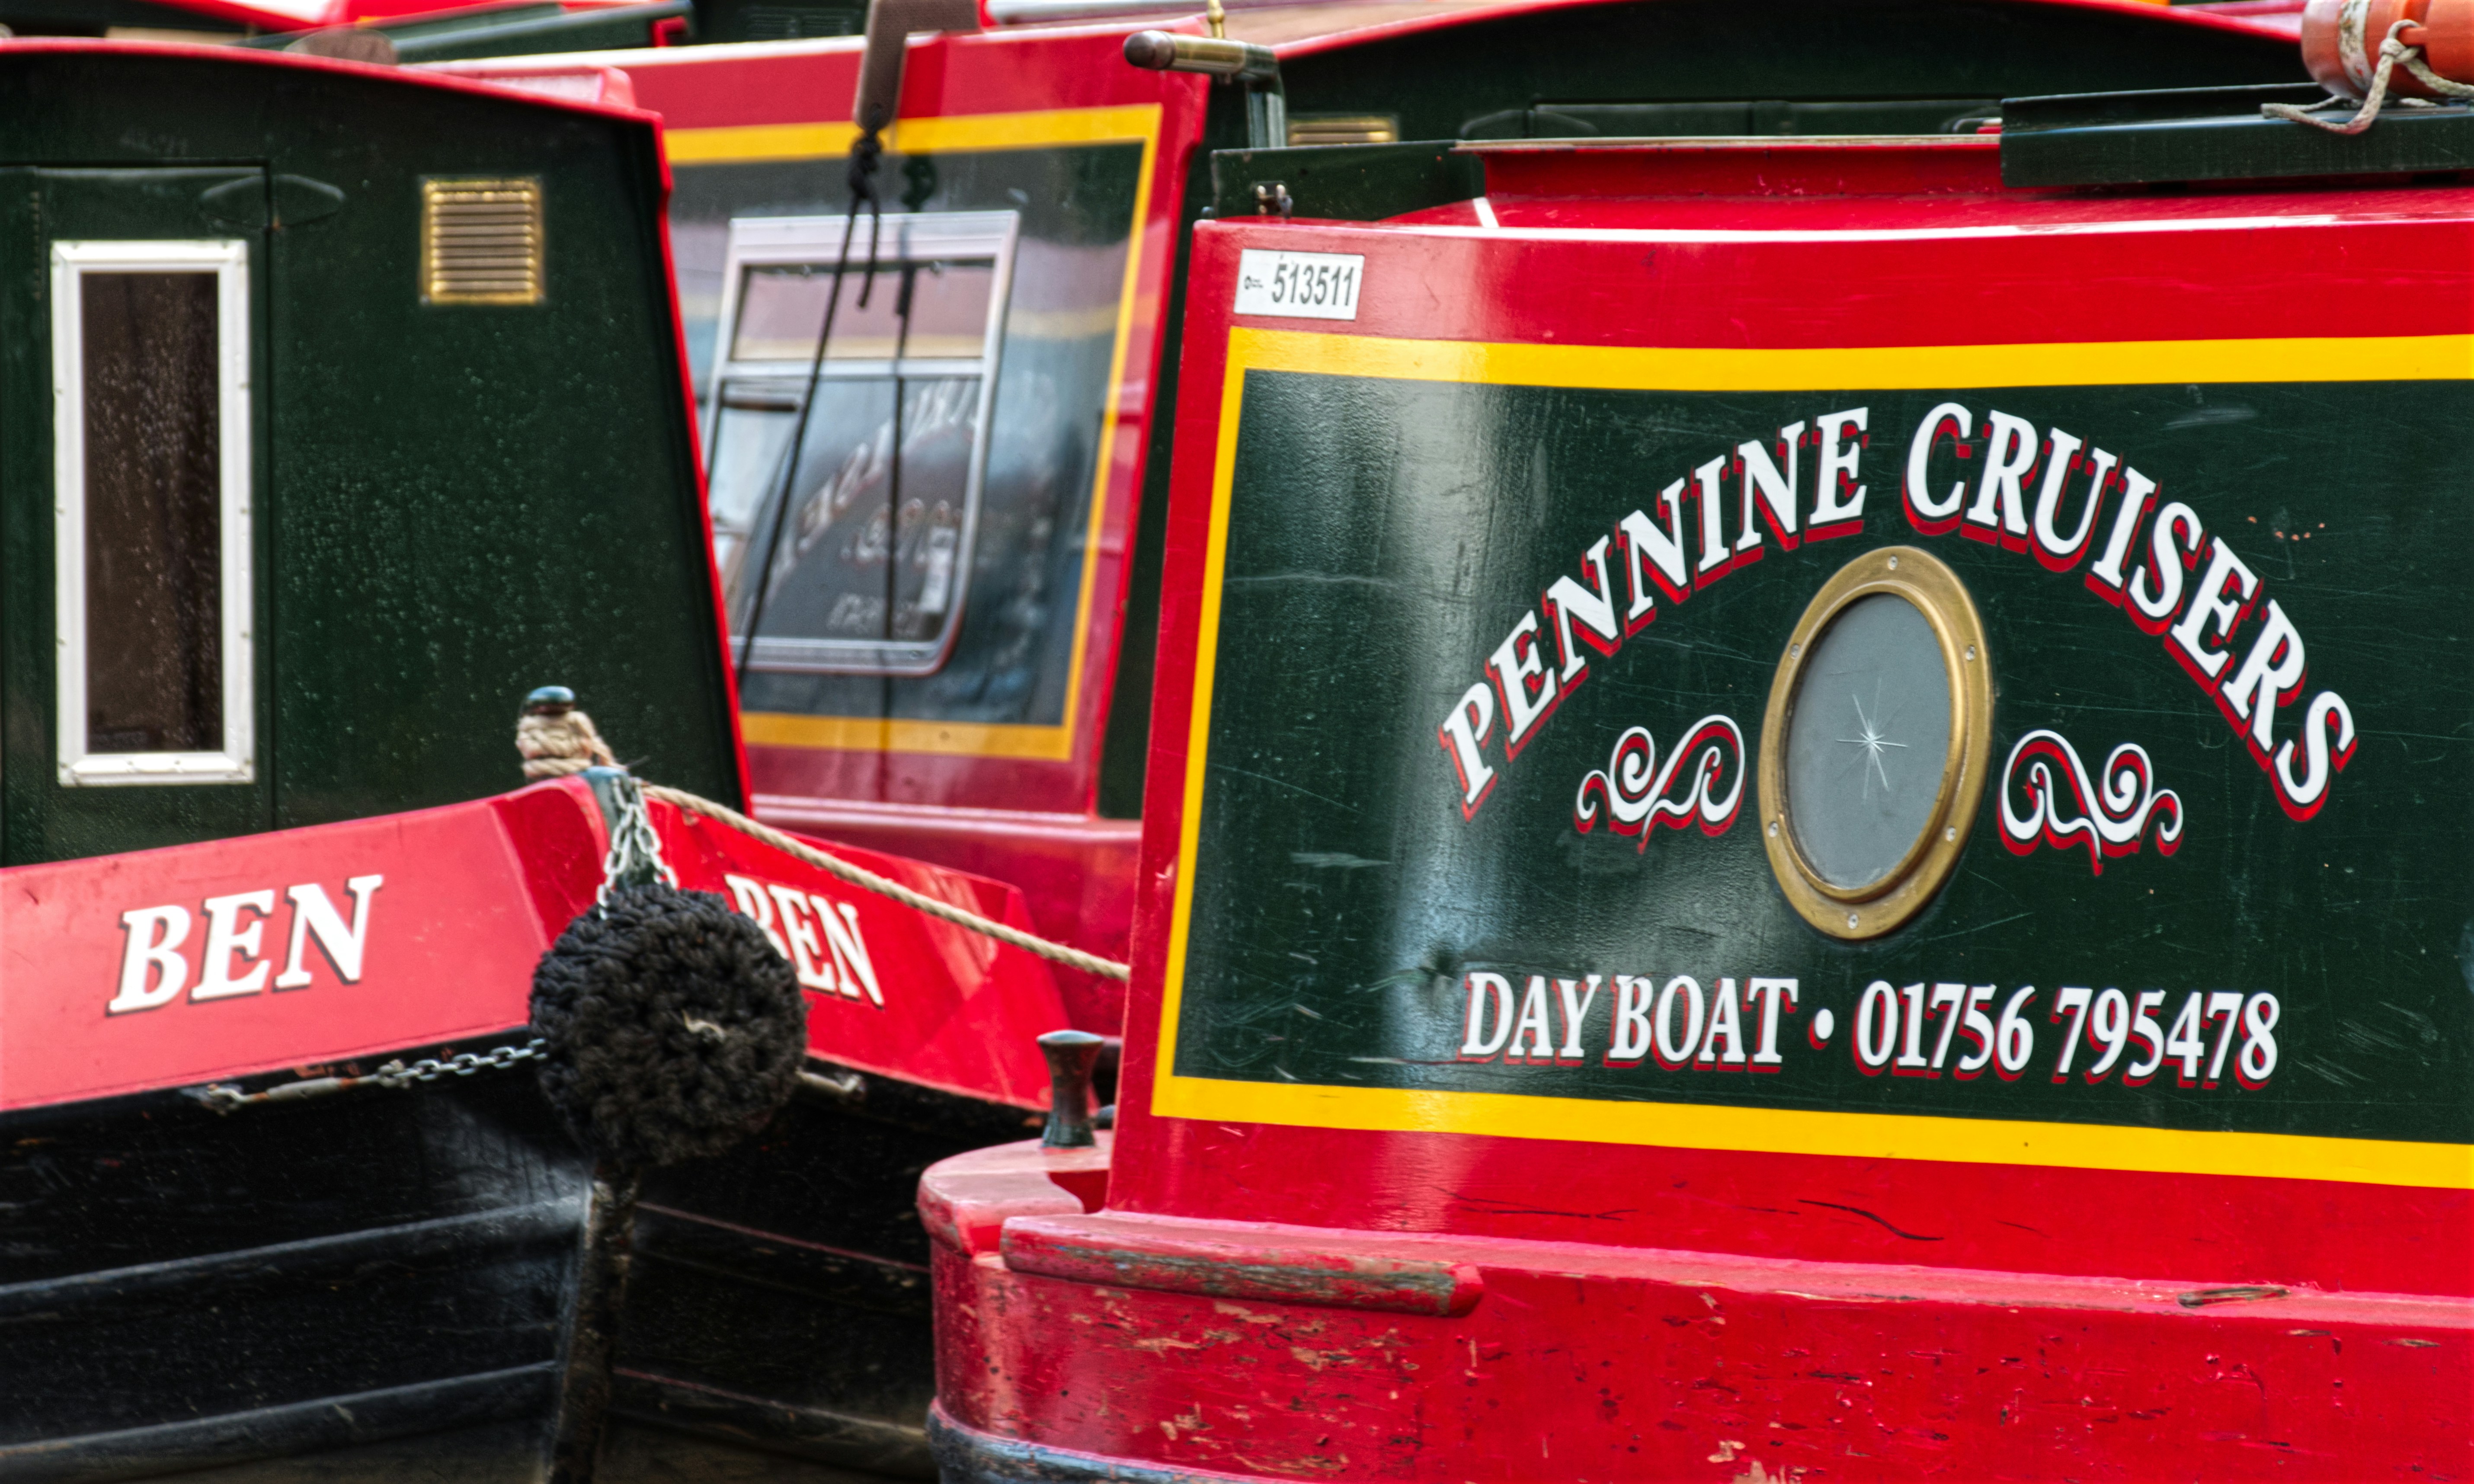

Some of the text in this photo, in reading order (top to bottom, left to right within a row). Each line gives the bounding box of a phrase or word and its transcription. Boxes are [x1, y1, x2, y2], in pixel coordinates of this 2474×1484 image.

[1271, 263, 1354, 306] 513511
[1441, 406, 1869, 818] PENNINE
[1903, 402, 2356, 820] CRUISERS
[106, 874, 383, 1016] BEN
[1457, 972, 2281, 1091] DAY BOAT 01756 795478
